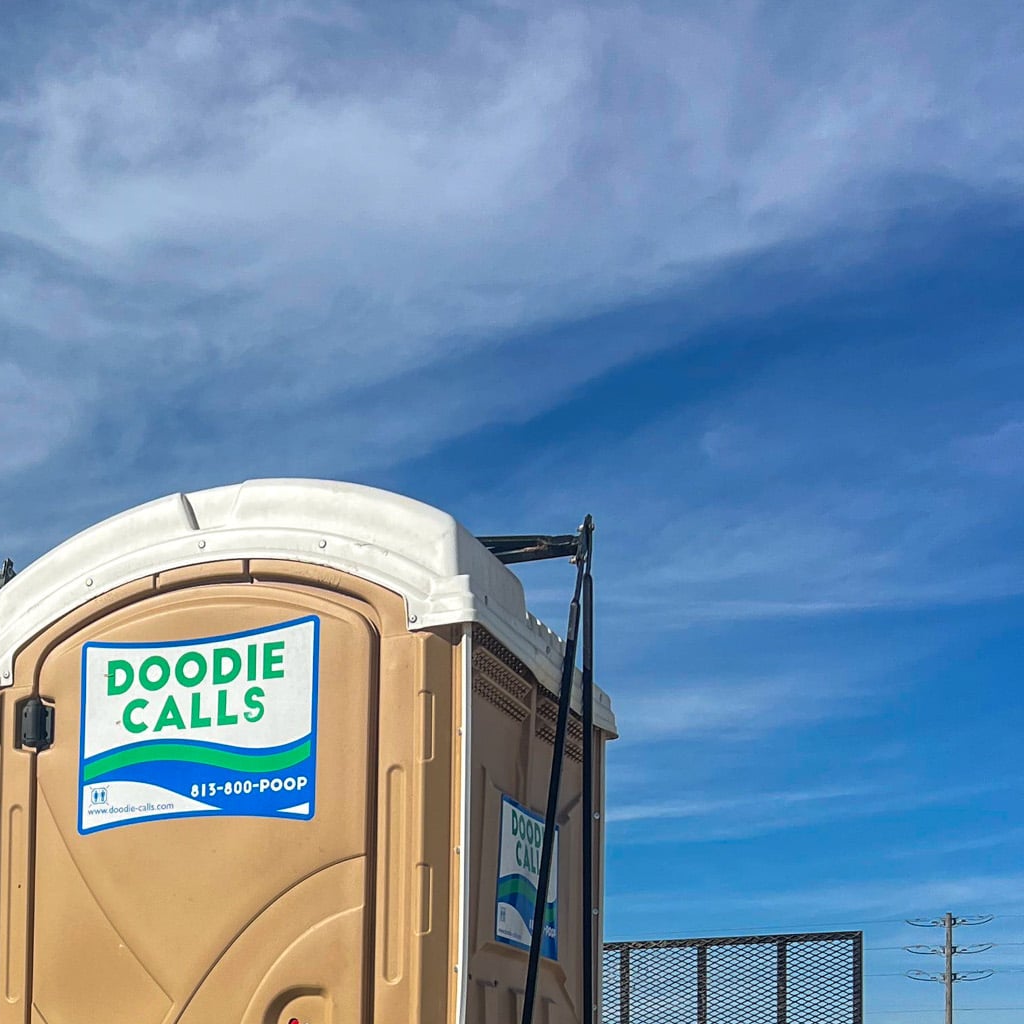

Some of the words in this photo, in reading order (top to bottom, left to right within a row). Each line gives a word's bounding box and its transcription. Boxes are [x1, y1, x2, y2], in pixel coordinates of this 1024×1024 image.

[107, 640, 285, 696] DOODIE
[122, 686, 265, 734] CALLS
[190, 776, 308, 798] 813-800-POOP
[88, 802, 174, 816] www.doodie-calls.com
[511, 809, 545, 848] DOOD
[516, 840, 540, 875] CAL
